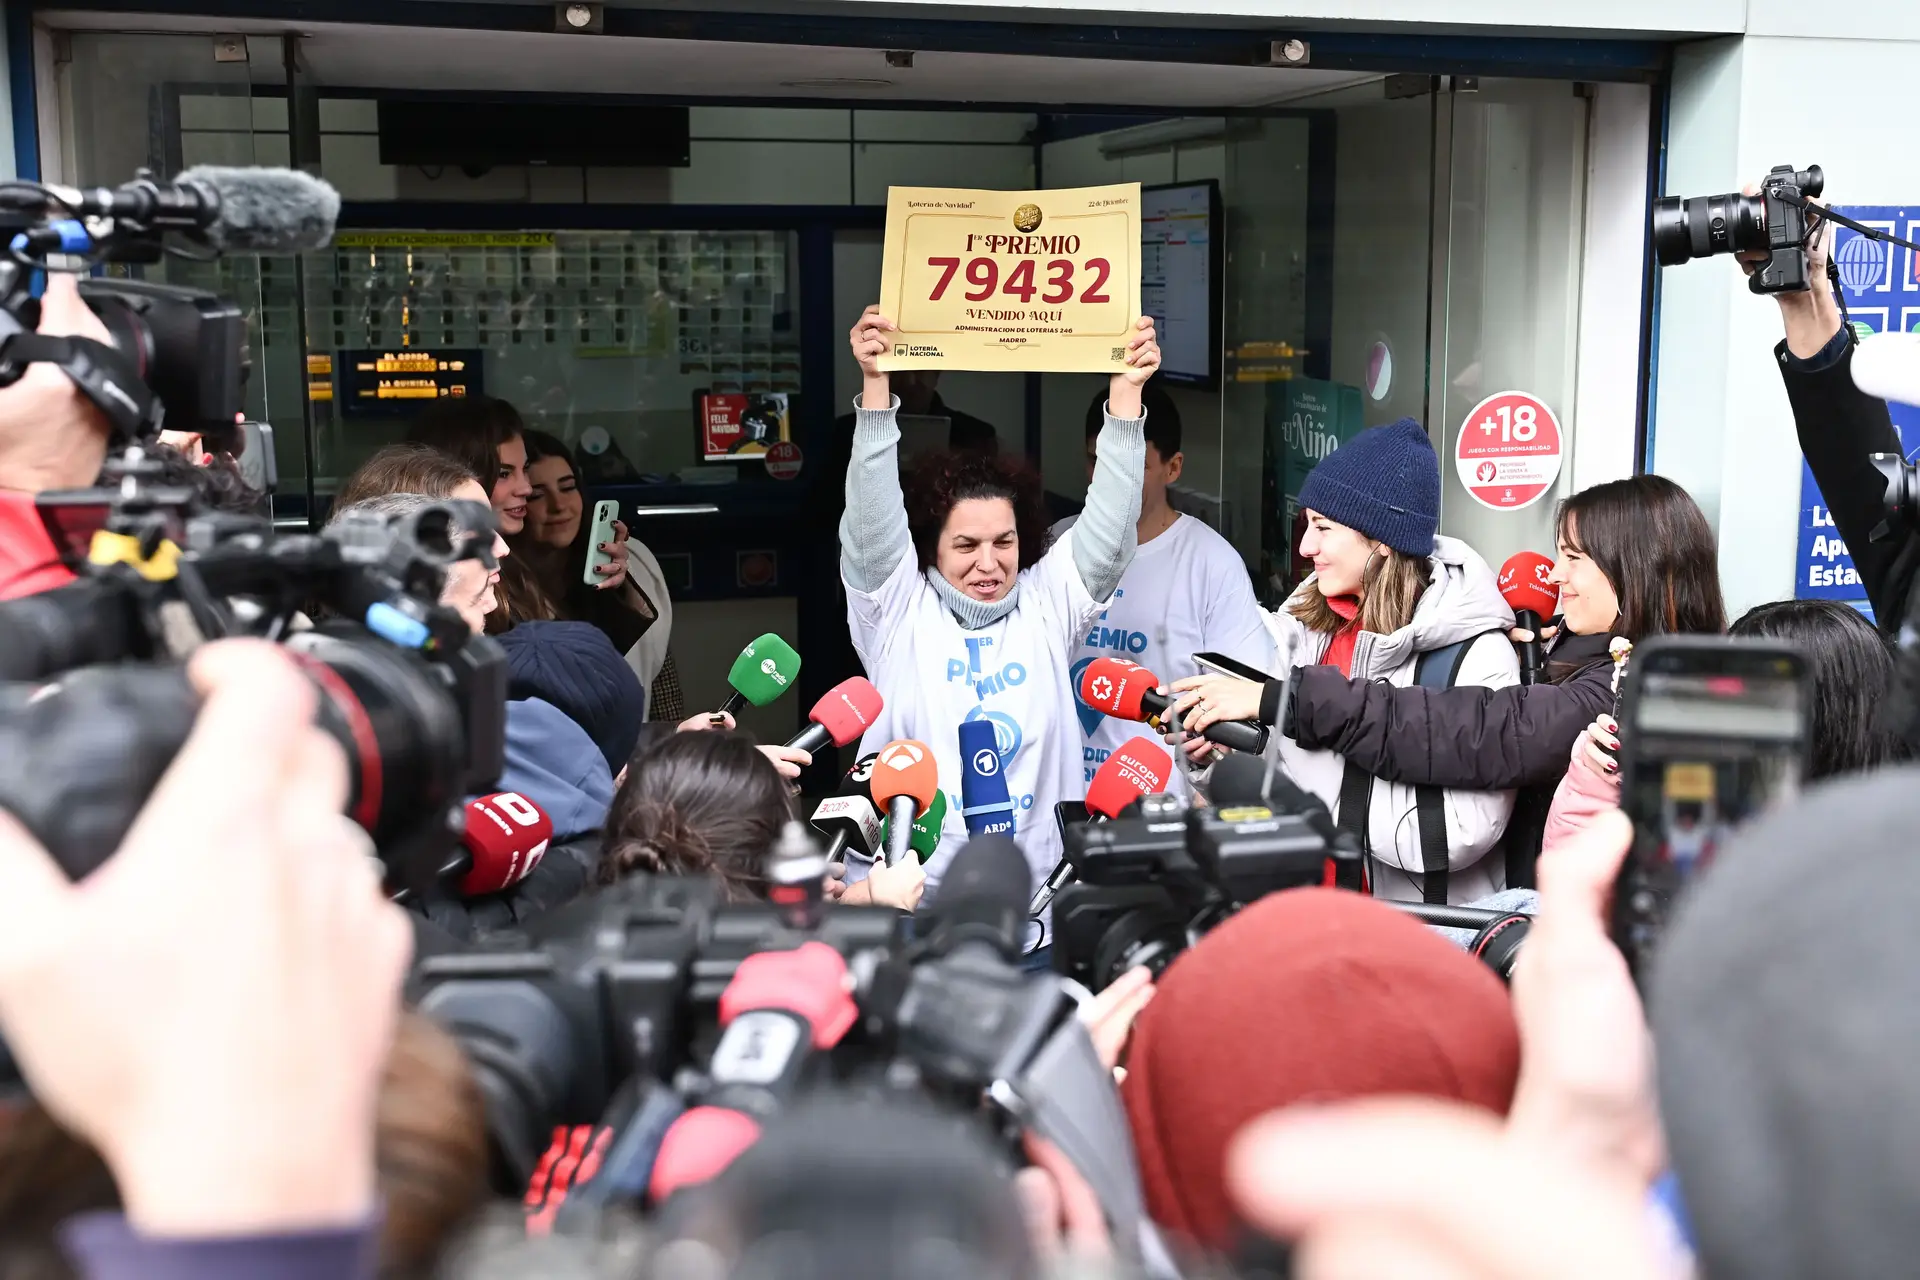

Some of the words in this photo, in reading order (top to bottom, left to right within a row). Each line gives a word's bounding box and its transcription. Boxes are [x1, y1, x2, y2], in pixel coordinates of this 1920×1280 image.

[985, 234, 1081, 254] PREMIO
[928, 256, 1111, 304] 79432
[955, 325, 1015, 333] ADMINISTRACION
[965, 308, 1026, 321] VENDIDO
[1028, 308, 1063, 323] AQUÍ
[710, 414, 729, 424] FELIZ
[711, 424, 740, 435] NAVIDAD
[1479, 405, 1538, 443] +18
[1291, 412, 1339, 462] Niño
[1500, 445, 1552, 453] RESPONSABILIDAD
[1085, 625, 1148, 654] EMIO
[946, 657, 1027, 701] PMIO
[1111, 677, 1128, 711] TeleMadrid
[1117, 767, 1152, 795] press
[1120, 754, 1160, 786] europa
[983, 822, 1007, 835] ARD
